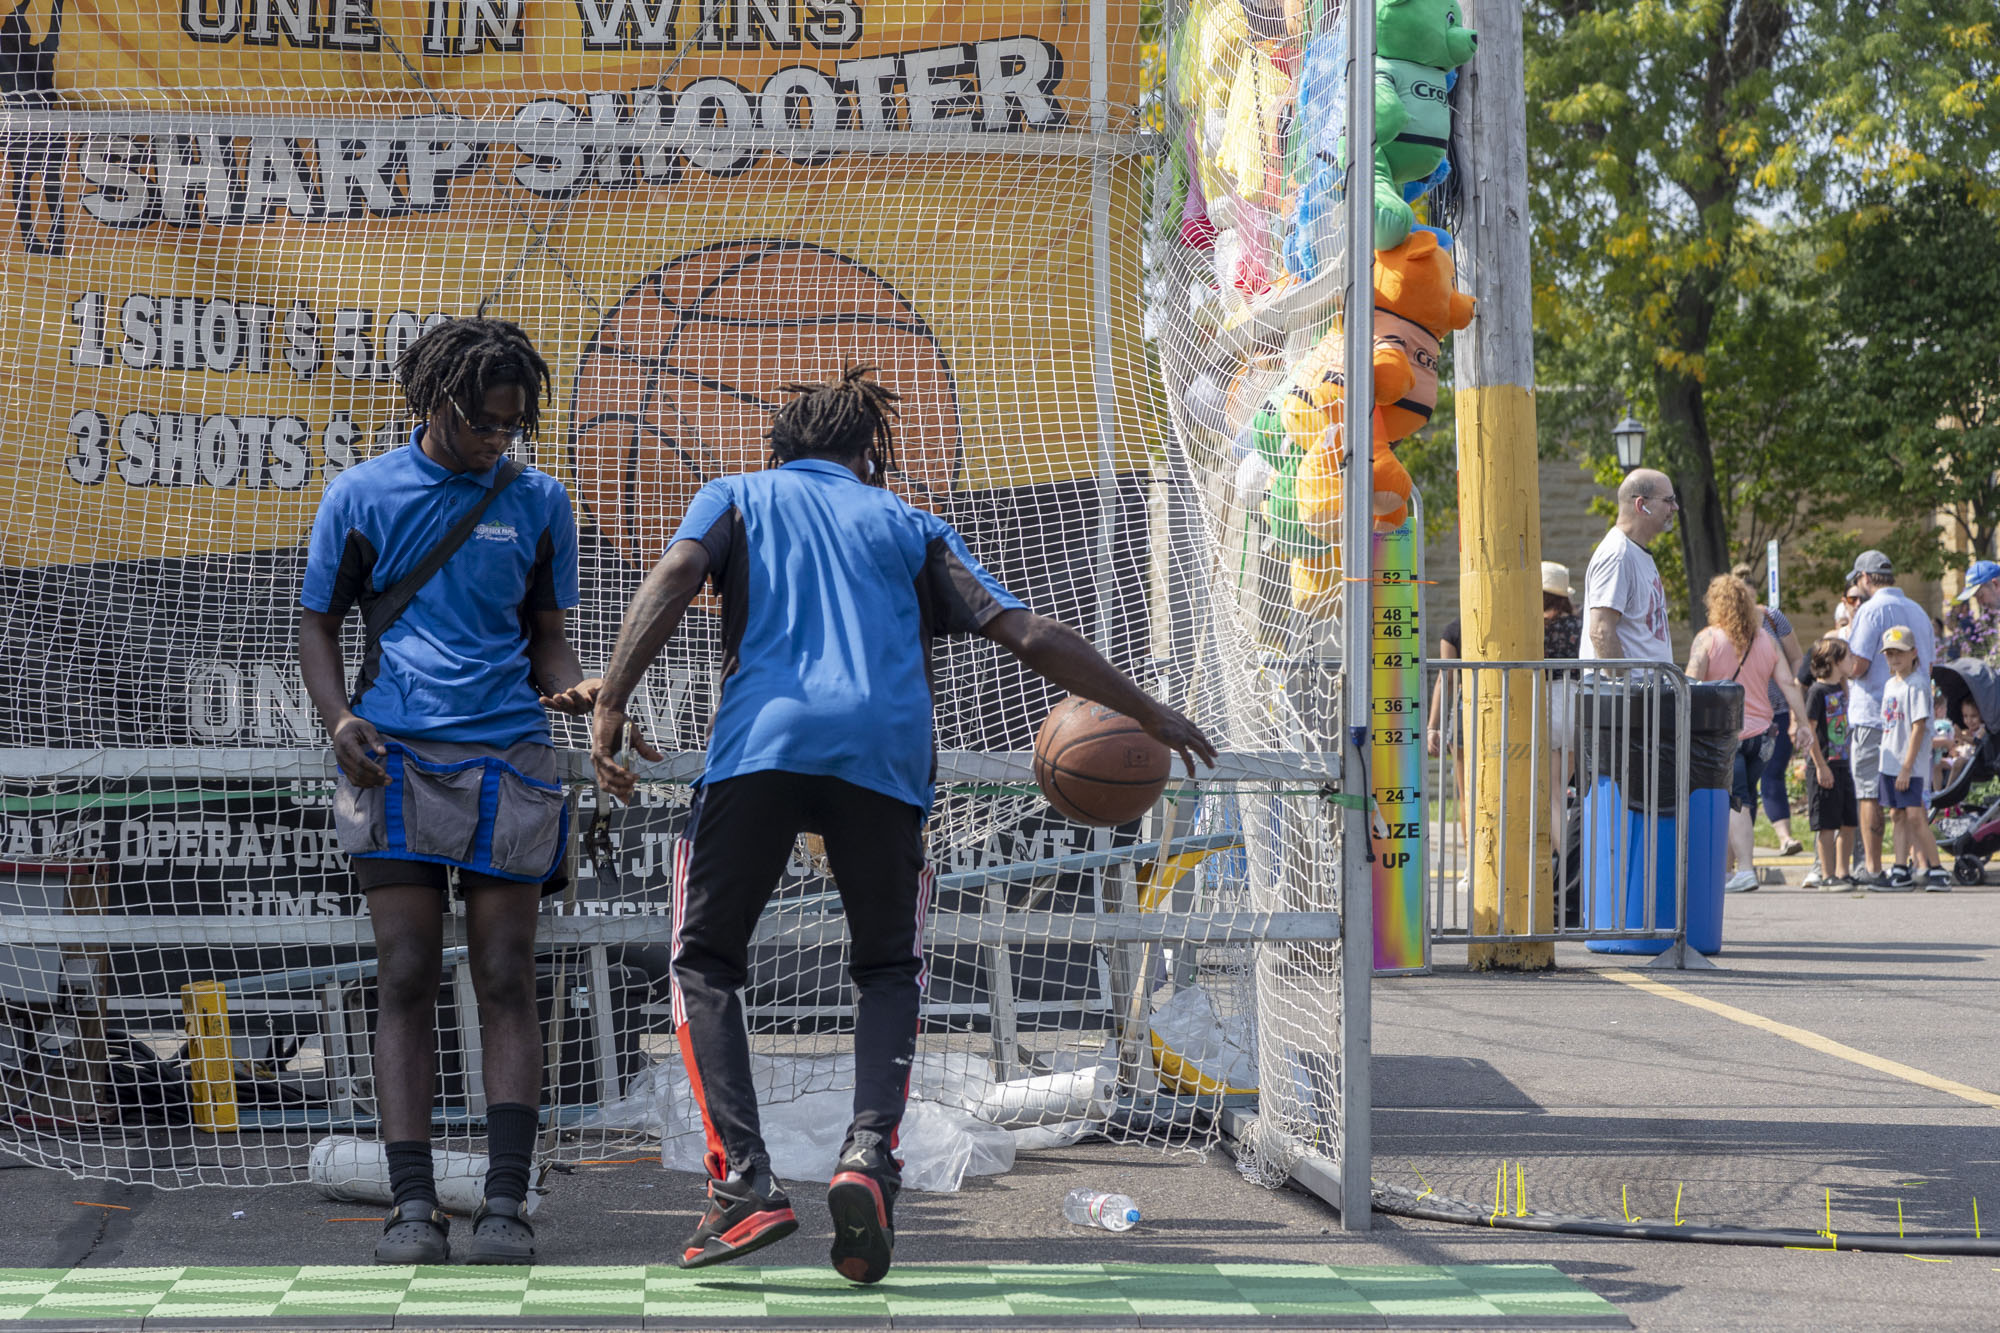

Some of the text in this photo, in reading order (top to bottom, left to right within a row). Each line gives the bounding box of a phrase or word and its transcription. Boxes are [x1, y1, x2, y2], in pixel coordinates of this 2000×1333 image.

[181, 0, 863, 57] ONE IN WINS
[79, 36, 1070, 229] SHARP SHOOTER
[118, 293, 273, 373] SHOT
[66, 409, 109, 486] 3
[116, 411, 313, 490] SHOTS
[1383, 572, 1401, 584] 52
[1383, 609, 1402, 621] 48
[1383, 625, 1402, 638] 46
[1384, 655, 1402, 667] 42
[1384, 700, 1403, 712] 36
[1385, 731, 1403, 743] 32
[1386, 789, 1404, 802] 24
[0, 819, 106, 859] AME
[1382, 852, 1410, 869] UP
